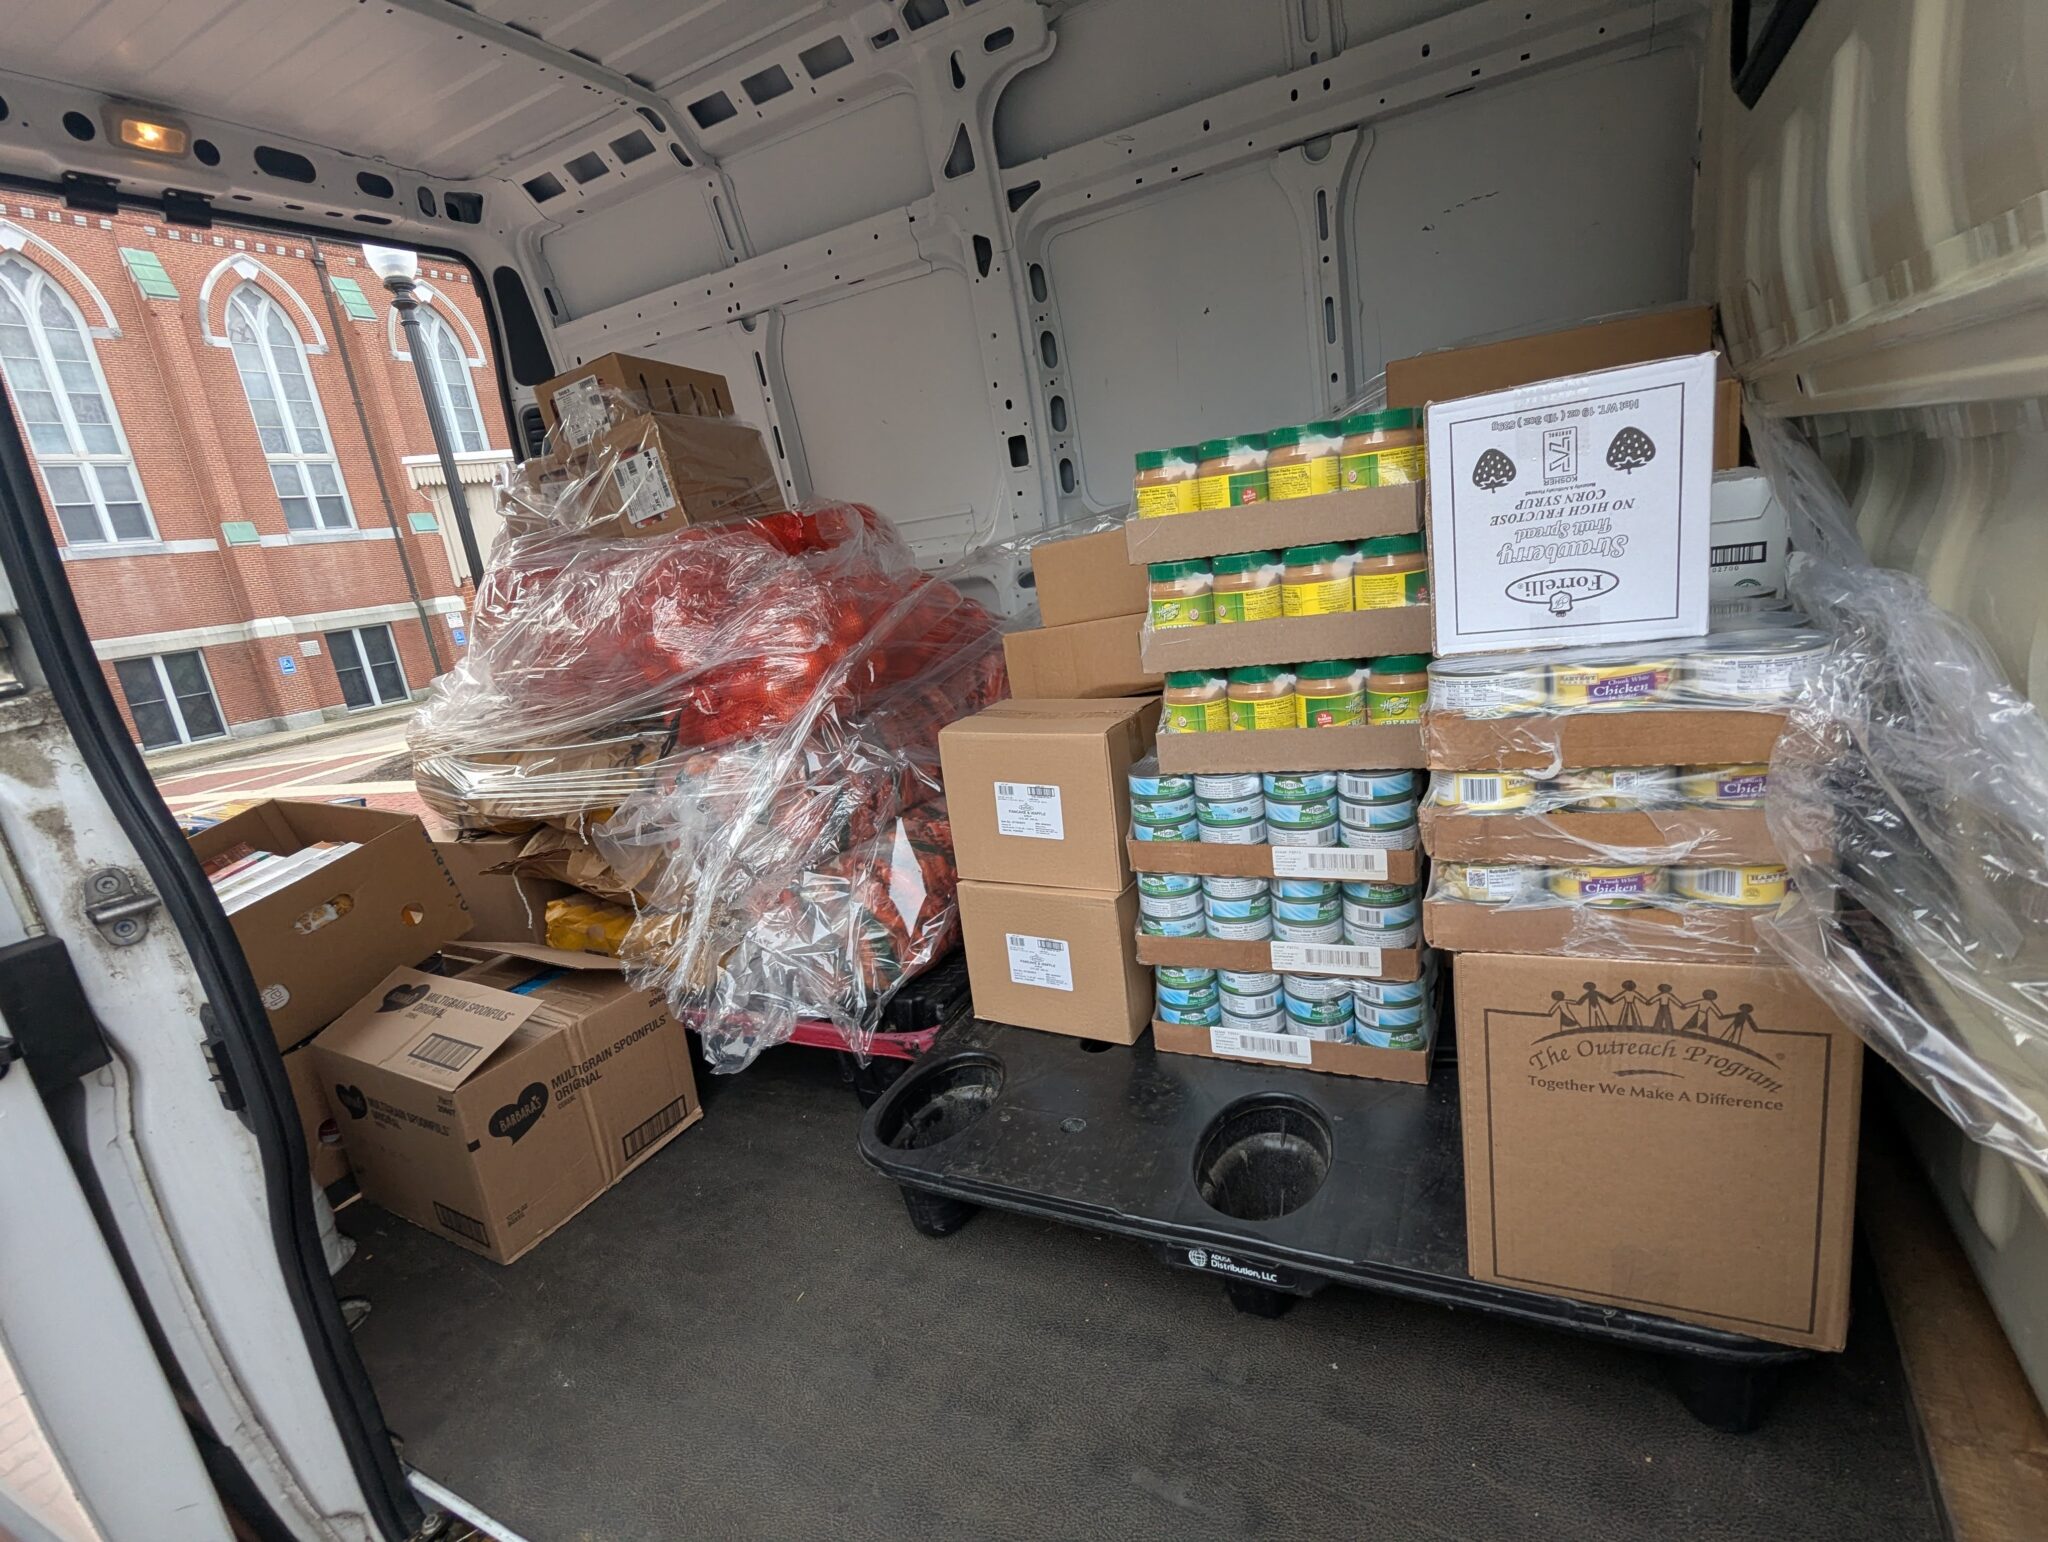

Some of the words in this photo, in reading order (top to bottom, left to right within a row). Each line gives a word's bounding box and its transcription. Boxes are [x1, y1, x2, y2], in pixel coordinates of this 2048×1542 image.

[1567, 410, 1580, 418] oz
[1582, 407, 1595, 417] 19
[1620, 399, 1639, 411] Net
[1543, 475, 1578, 486] KOSHER
[1515, 495, 1562, 510] SYRUP
[1564, 489, 1606, 501] CORN
[1568, 502, 1609, 516] HIGH
[1612, 498, 1635, 511] NO
[1490, 507, 1565, 526] FRUCTOSE
[1514, 520, 1570, 543] Spread
[1572, 517, 1612, 535] Fruit
[1496, 534, 1629, 565] Strawberry
[1524, 574, 1604, 597] Forrelli
[1593, 683, 1649, 697] Chicken
[1724, 783, 1766, 794] Chick
[1585, 883, 1637, 894] Chicken
[426, 992, 467, 1010] MULTIGRAIN
[466, 1002, 511, 1021] SPOONFULS
[551, 1047, 613, 1090] MULTIGRAIN
[613, 1015, 667, 1054] SPOONFULS
[1529, 1045, 1571, 1071] The
[1577, 1039, 1677, 1059] Outreach
[1682, 1046, 1783, 1094] Program
[554, 1069, 602, 1102] ORIGINAL
[1528, 1074, 1596, 1093] Together
[1599, 1083, 1625, 1097] We
[1630, 1086, 1675, 1102] Make
[1678, 1091, 1691, 1102] A
[1696, 1092, 1783, 1111] Difference
[499, 1095, 542, 1133] BARBARA'S
[1211, 1259, 1261, 1279] Distribution,
[1262, 1271, 1277, 1282] LLC
